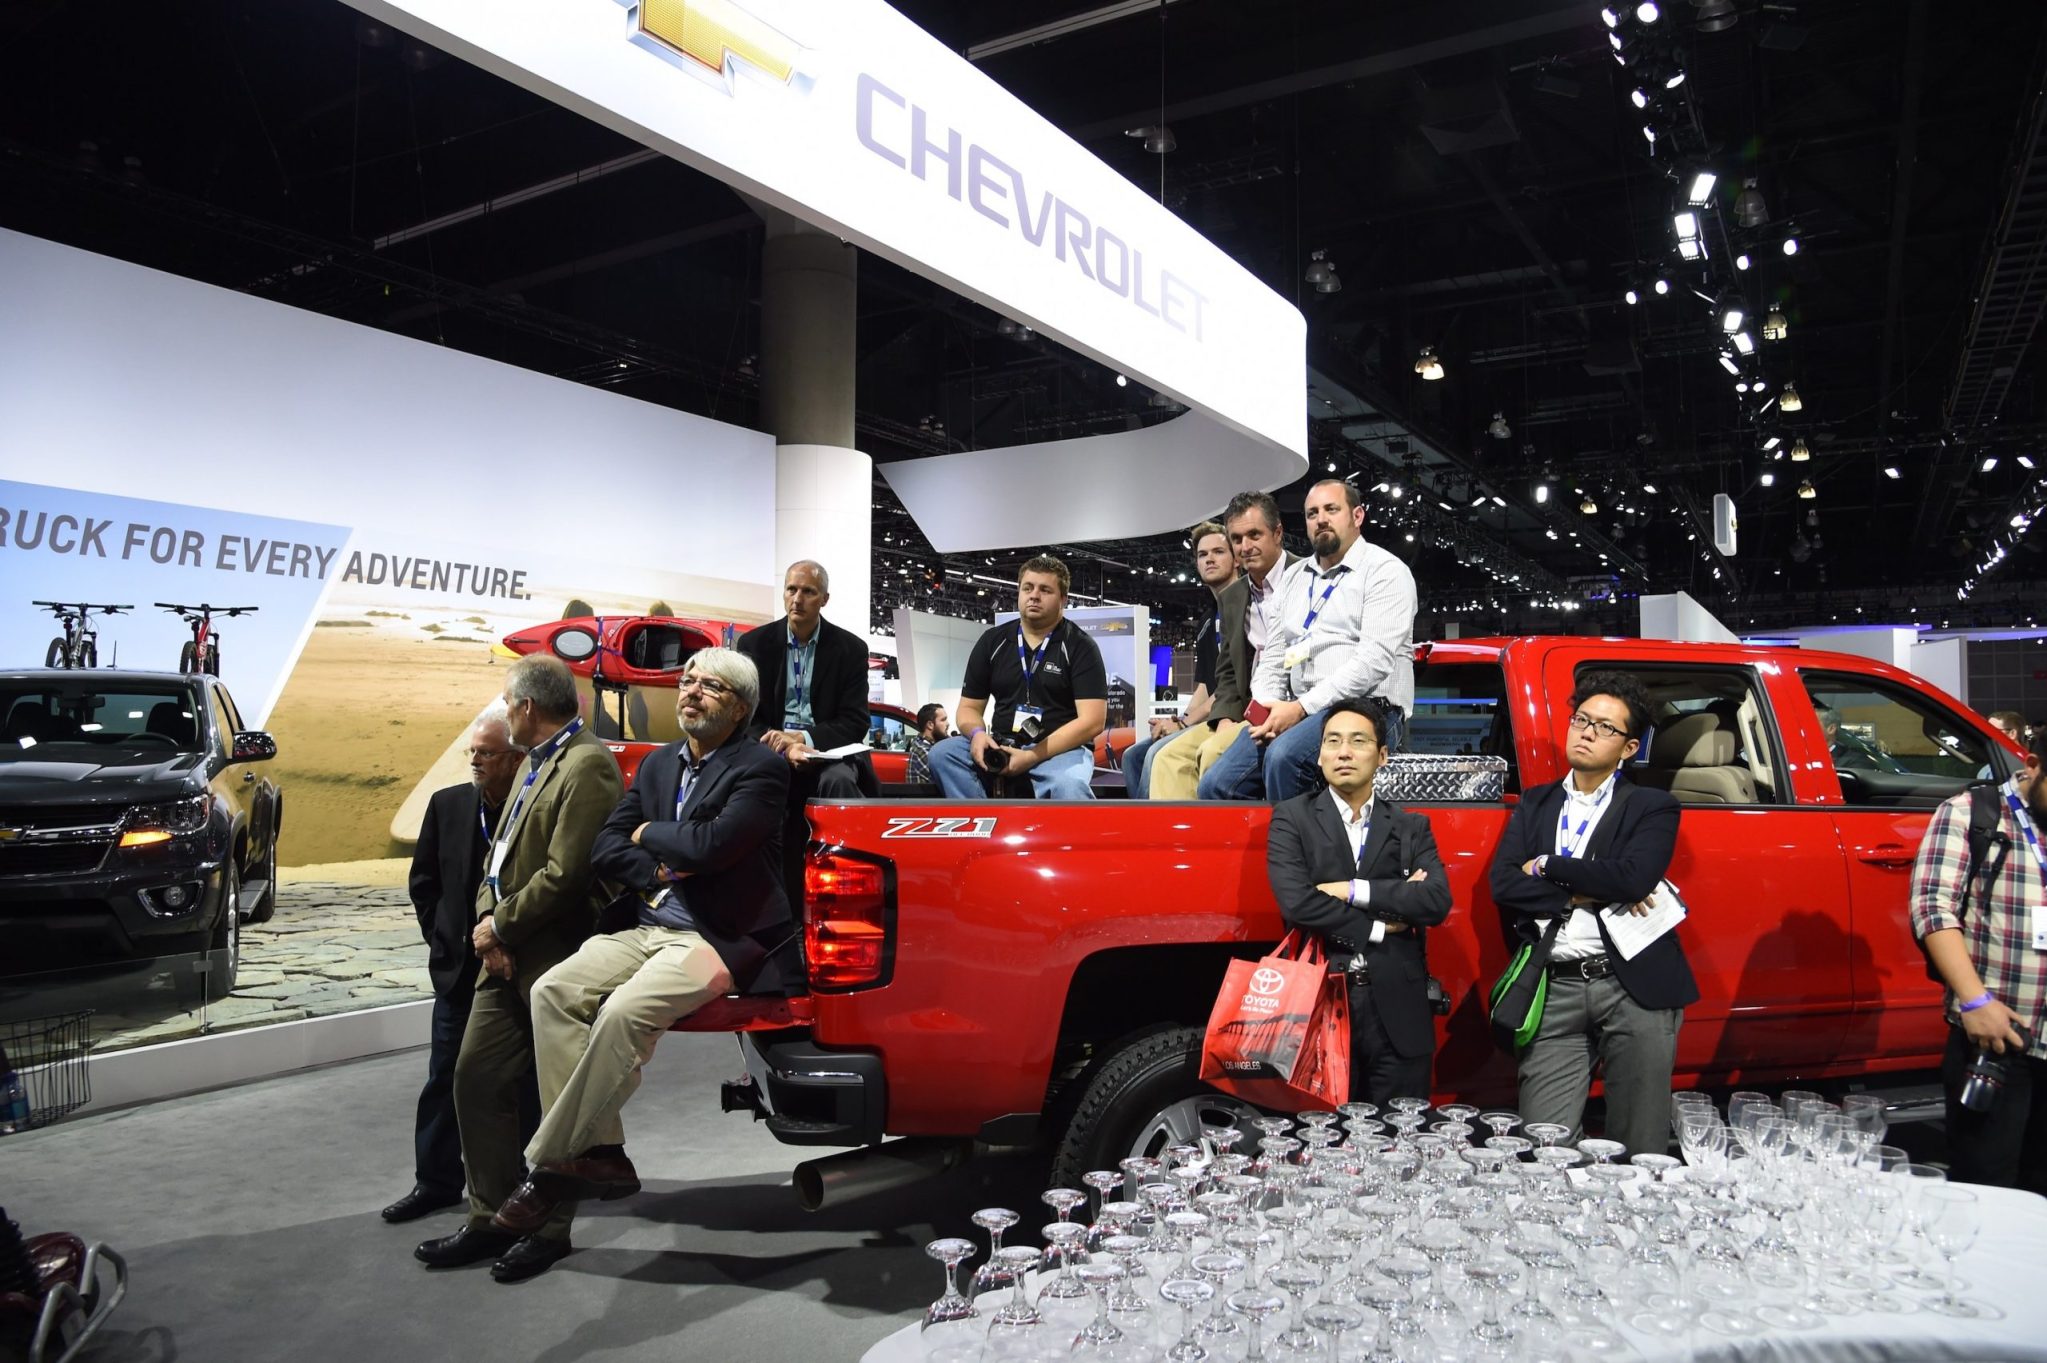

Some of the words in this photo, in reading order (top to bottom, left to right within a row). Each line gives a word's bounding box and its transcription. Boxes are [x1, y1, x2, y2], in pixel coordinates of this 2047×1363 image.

[856, 72, 1210, 342] CHEVROLET
[122, 524, 205, 567] FOR
[216, 535, 337, 580] EVERY
[343, 551, 531, 600] ADVENTURE.
[881, 817, 997, 838] Z71
[1241, 994, 1280, 1008] TOYOTA
[1234, 1061, 1261, 1070] ANGELES
